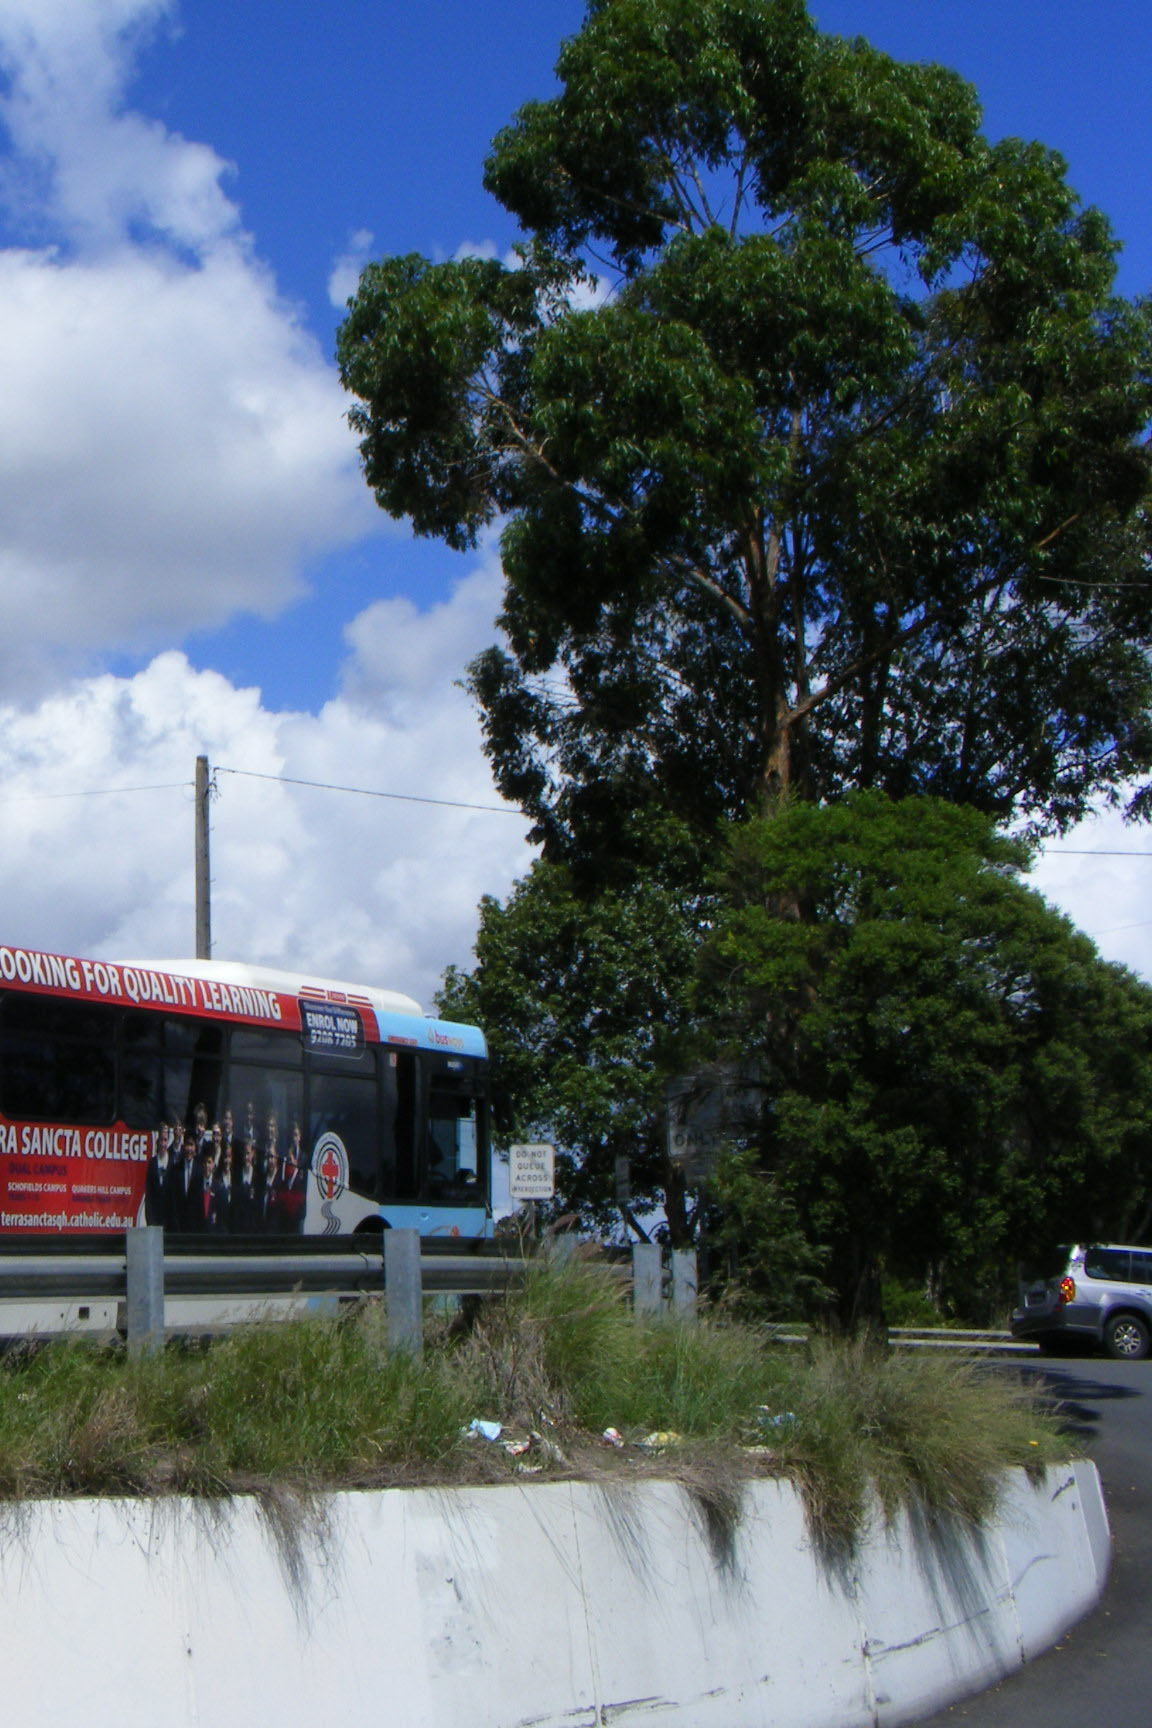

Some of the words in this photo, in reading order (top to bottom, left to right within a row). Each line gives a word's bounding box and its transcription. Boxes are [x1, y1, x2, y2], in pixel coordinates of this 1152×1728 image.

[82, 961, 123, 997] FOR
[122, 967, 198, 1007] QUALITY
[199, 979, 282, 1021] LEARNING
[306, 1012, 336, 1031] ENROL
[336, 1017, 359, 1034] NOW
[21, 1126, 82, 1158] SANCTA
[84, 1131, 148, 1161] COLLEGE
[516, 1150, 527, 1158] DO
[531, 1150, 547, 1158] NOT
[8, 1163, 31, 1175] DUAL
[33, 1165, 67, 1177] CAMPUS
[517, 1162, 545, 1170] QUEUE
[516, 1174, 548, 1182] ACROSS
[7, 1182, 43, 1192] SCHOFIELDS
[43, 1183, 67, 1193] CAMPUS
[71, 1185, 97, 1194] QUAKERS
[97, 1186, 109, 1194] HILL
[109, 1187, 132, 1196] CAMPUS
